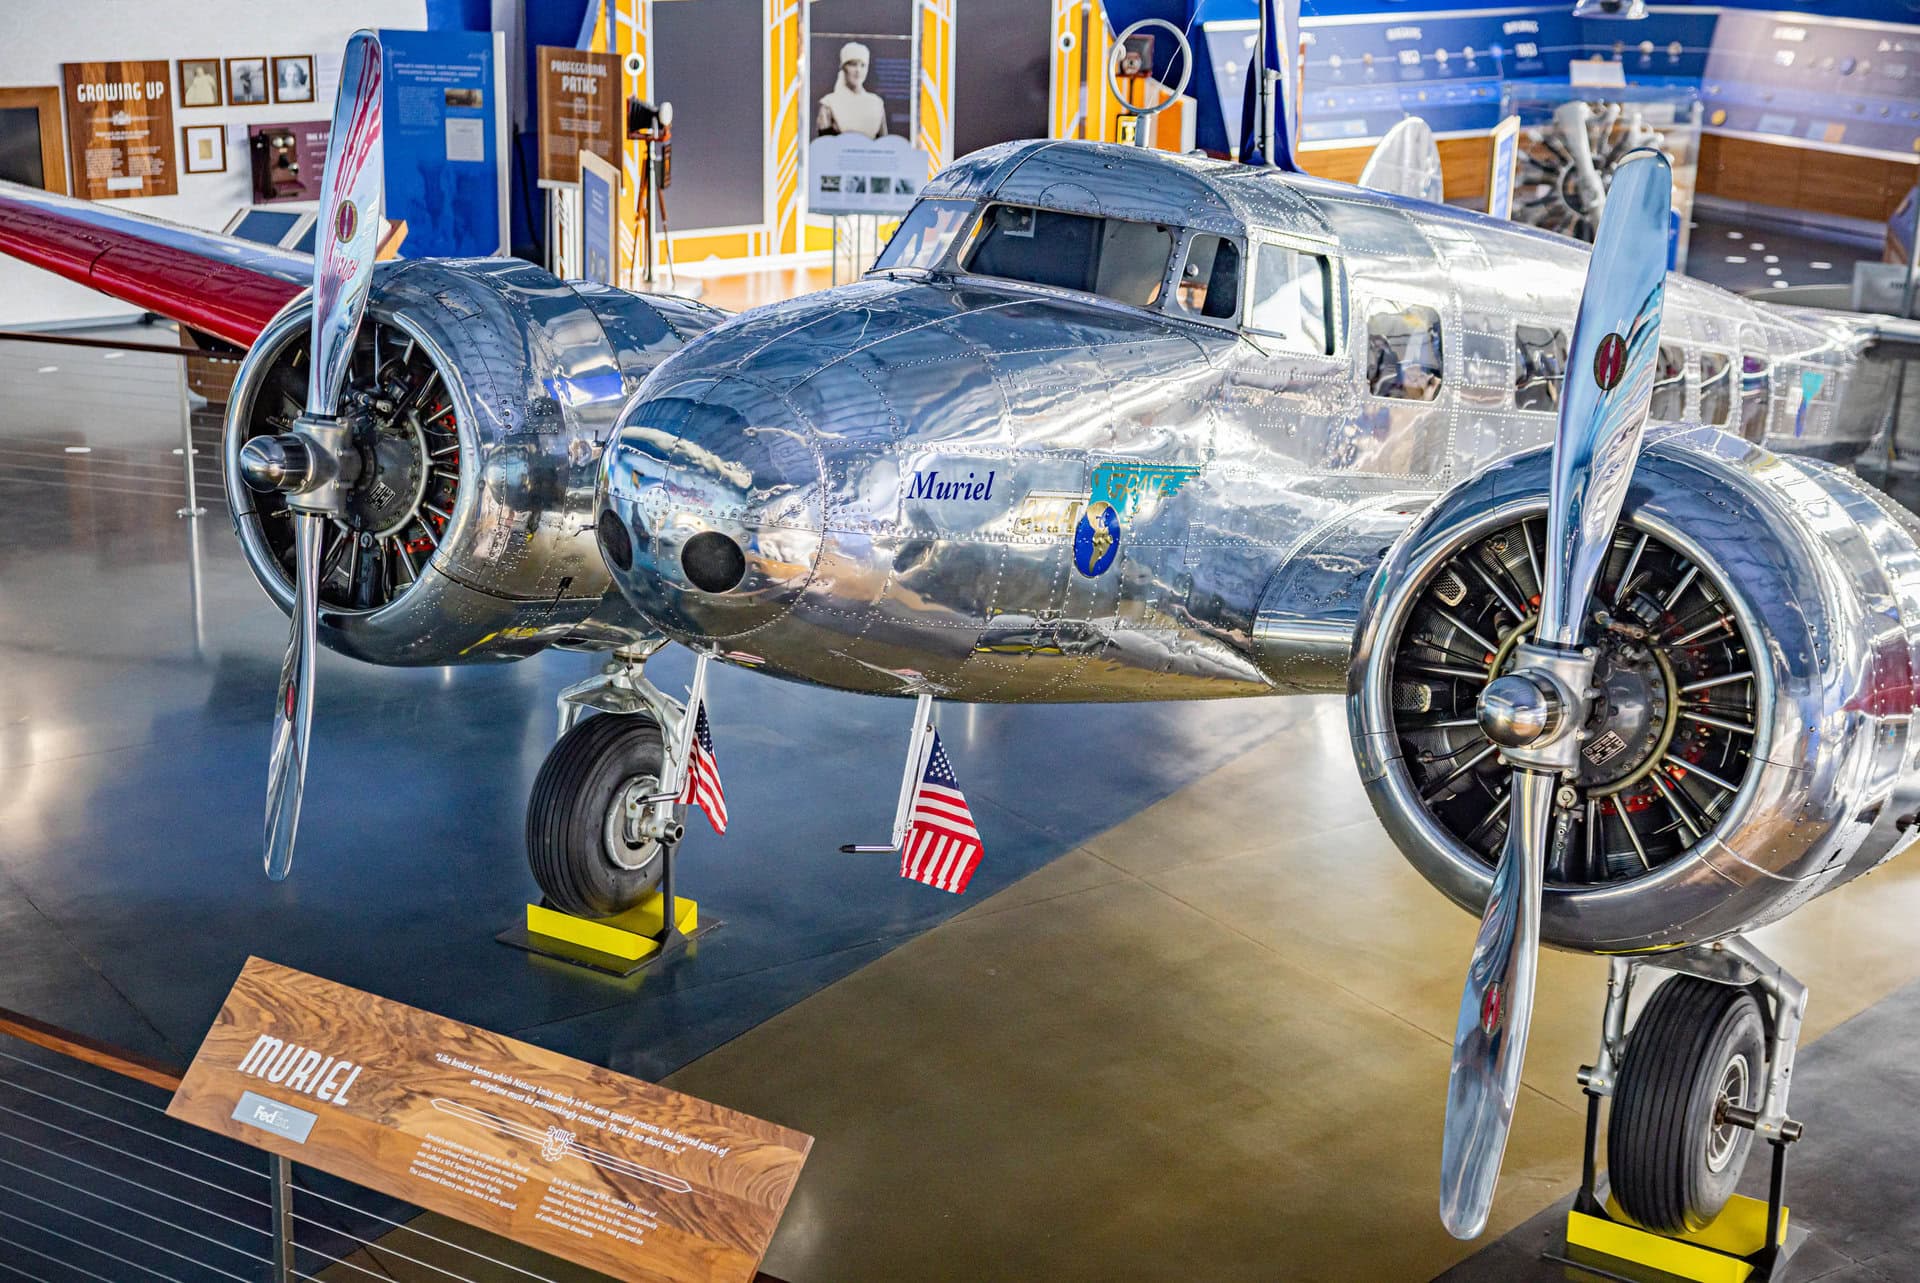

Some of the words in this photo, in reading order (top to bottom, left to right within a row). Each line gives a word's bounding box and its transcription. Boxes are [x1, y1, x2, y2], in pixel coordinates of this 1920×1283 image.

[77, 82, 142, 103] GROWING
[146, 81, 164, 100] UP
[562, 75, 598, 95] PATHS
[906, 471, 995, 501] Muriel
[238, 1034, 362, 1106] MURIEL
[450, 1058, 474, 1071] broken
[473, 1065, 493, 1078] bones
[492, 1073, 512, 1084] which
[512, 1078, 536, 1092] Nature
[536, 1086, 554, 1098] knits
[554, 1093, 574, 1106] slowly
[582, 1101, 595, 1111] her
[594, 1107, 610, 1116] own
[609, 1112, 635, 1124] special
[632, 1120, 660, 1135] process,
[661, 1128, 674, 1138] the
[673, 1132, 700, 1146] injured
[698, 1142, 718, 1153] parts
[718, 1148, 729, 1158] of
[479, 1082, 507, 1095] airplane
[506, 1091, 525, 1101] must
[532, 1101, 578, 1120] painstakingly
[578, 1115, 606, 1128] restored.
[608, 1123, 627, 1136] There
[644, 1136, 663, 1148] short
